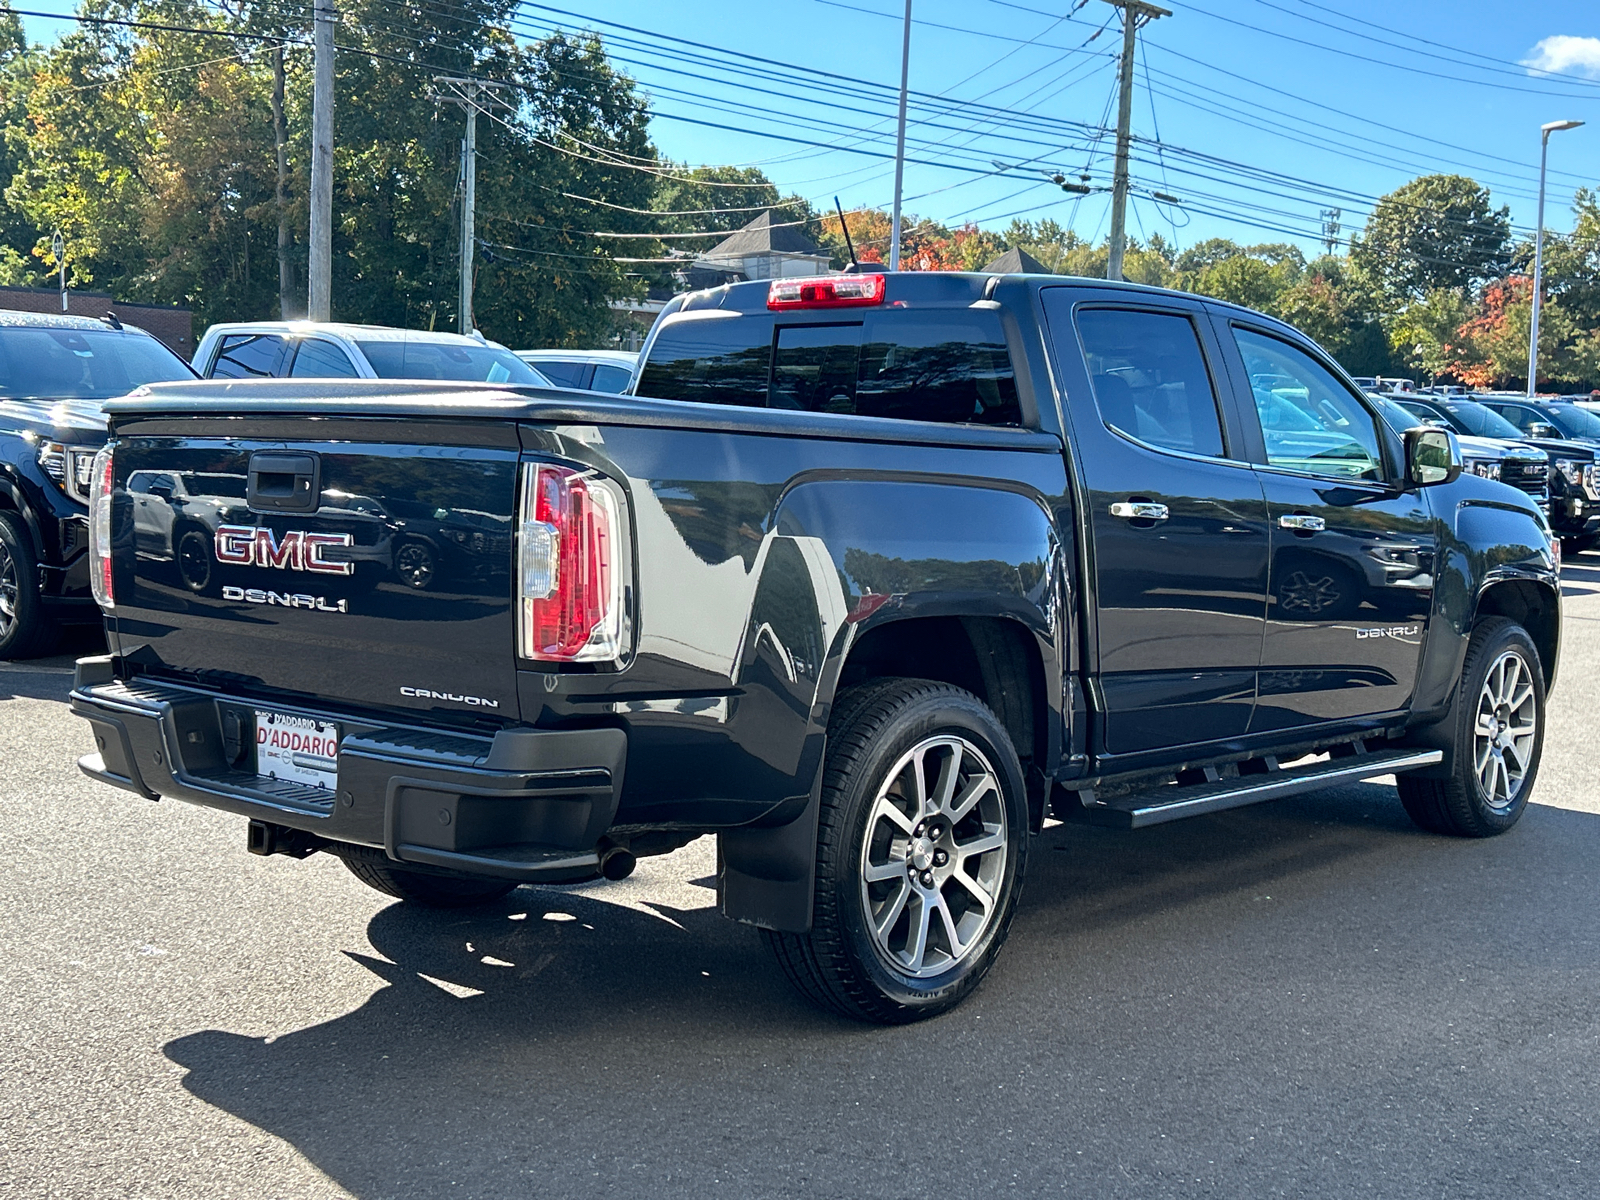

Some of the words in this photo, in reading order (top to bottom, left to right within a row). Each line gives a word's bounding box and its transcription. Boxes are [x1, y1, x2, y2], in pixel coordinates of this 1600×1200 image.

[214, 524, 354, 576] GMC
[222, 585, 348, 614] DENALI
[1356, 626, 1418, 639] DENALI
[400, 686, 499, 708] CANYON
[274, 713, 316, 730] D'ADDARIO
[257, 726, 337, 757] D'ADDARIO
